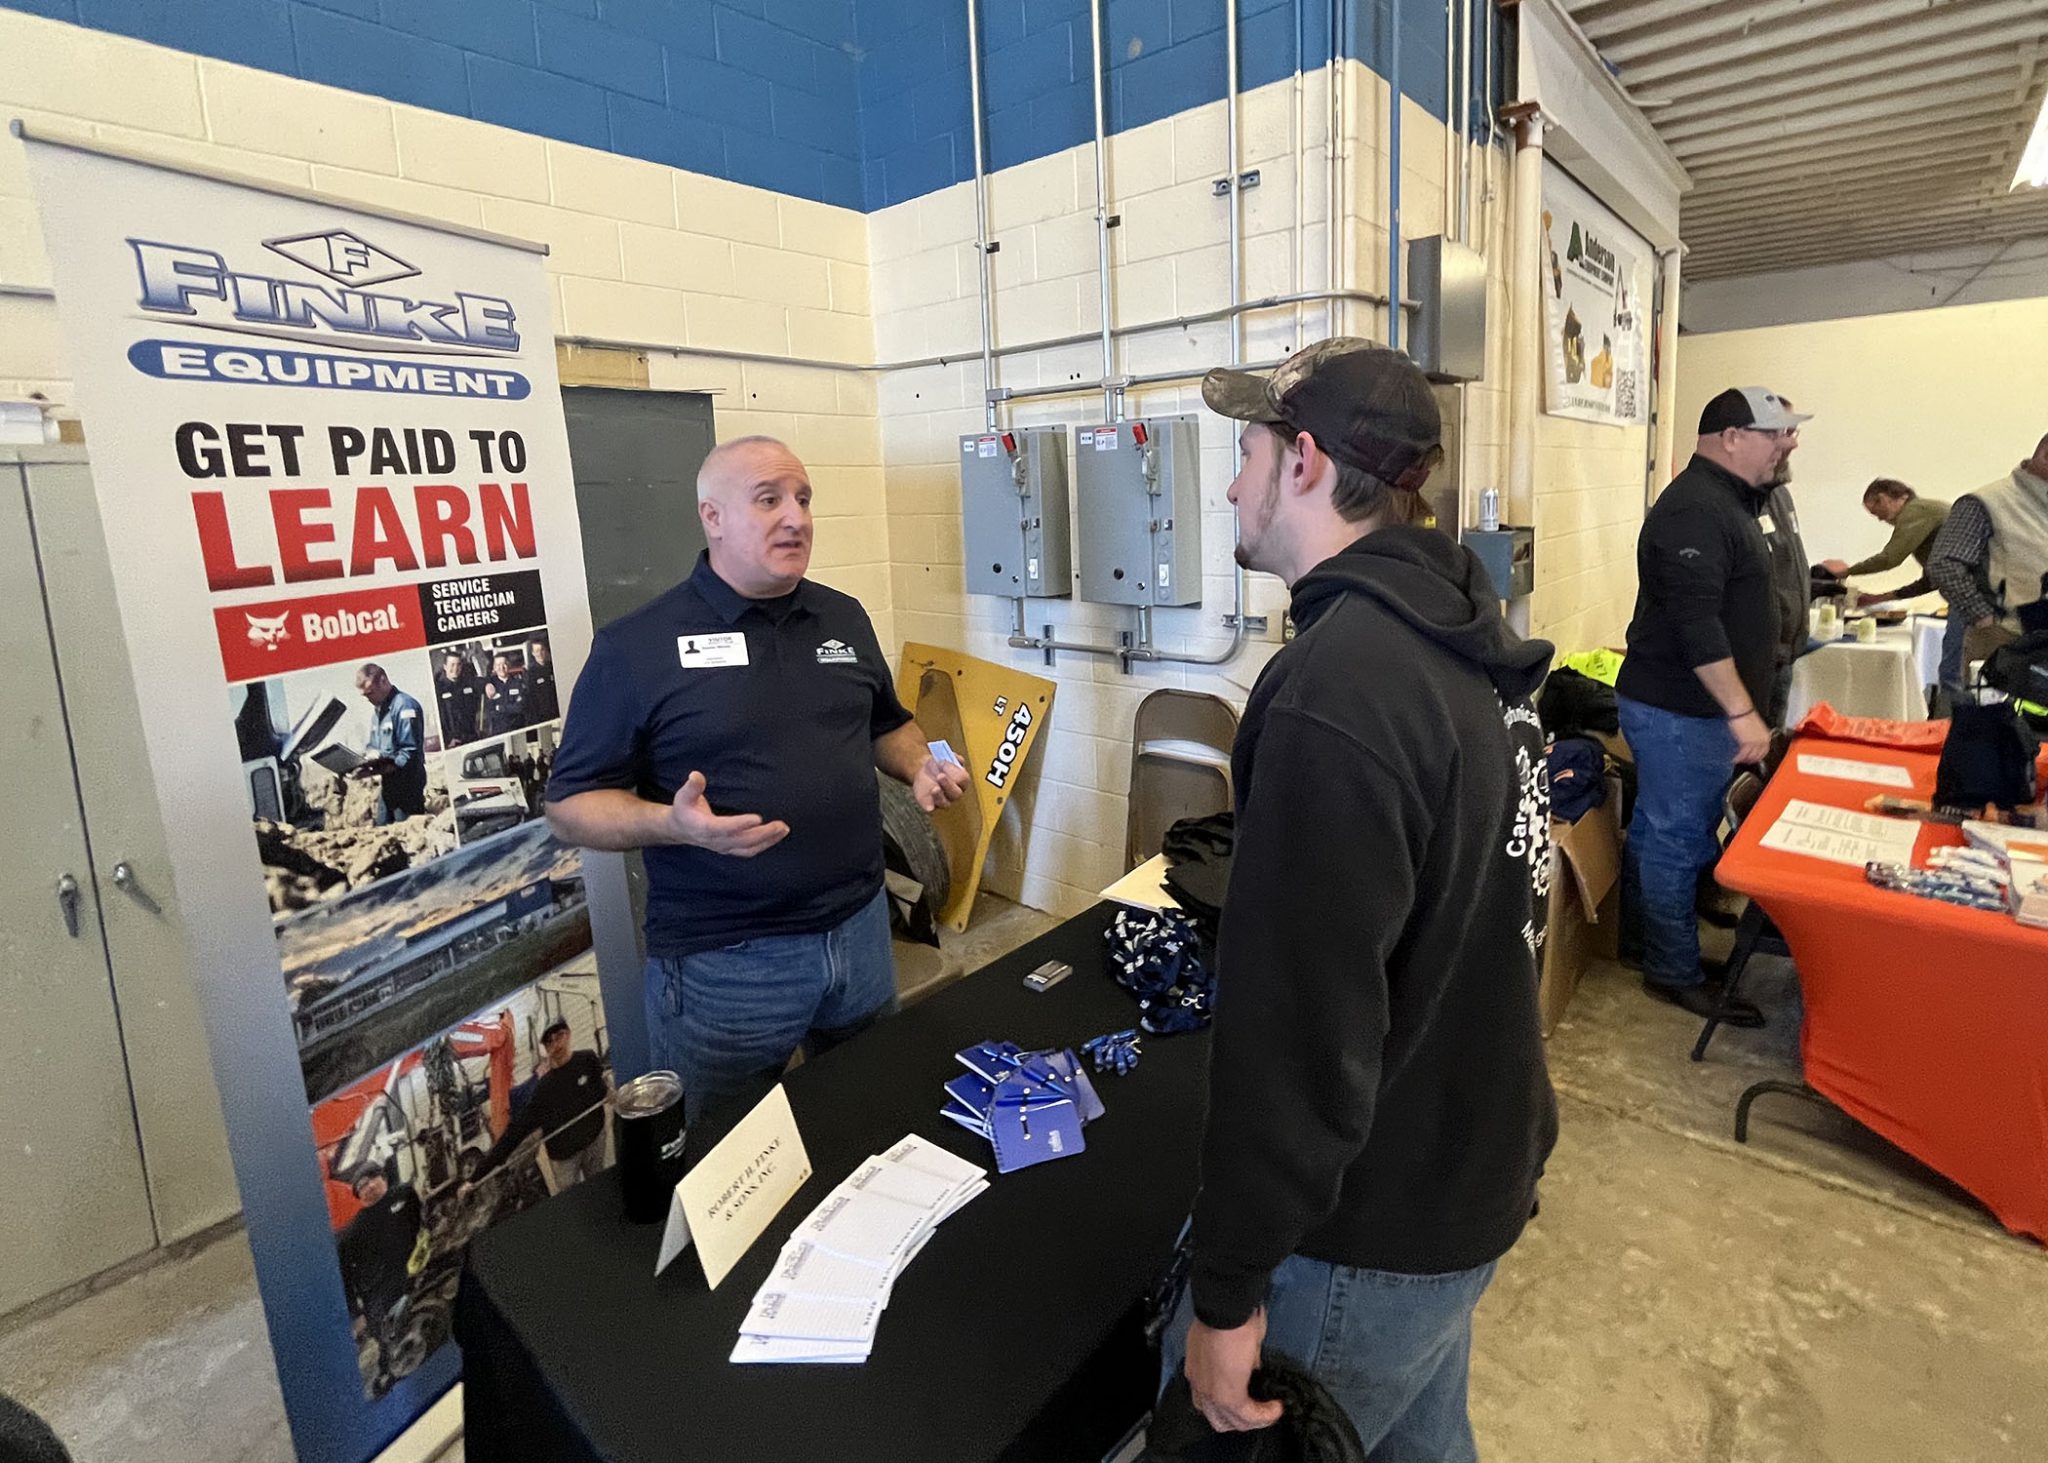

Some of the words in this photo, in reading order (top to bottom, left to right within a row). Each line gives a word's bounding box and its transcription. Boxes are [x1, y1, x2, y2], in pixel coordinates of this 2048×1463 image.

[326, 234, 370, 276] F
[125, 238, 520, 352] FINKE
[160, 346, 515, 396] EQUIPMENT
[175, 421, 304, 479] GET
[328, 426, 456, 476] PAID
[469, 430, 527, 474] TO
[191, 483, 537, 592] LEARN
[431, 578, 491, 599] SERVICE
[434, 590, 515, 615] TECHNICIAN
[302, 603, 399, 643] Bobcat
[437, 609, 500, 632] CAREERS
[816, 646, 855, 656] FINKE
[993, 695, 1008, 716] LT
[985, 702, 1033, 789] 450H
[707, 1172, 746, 1219] ROBERT
[754, 1134, 782, 1169] FINKE
